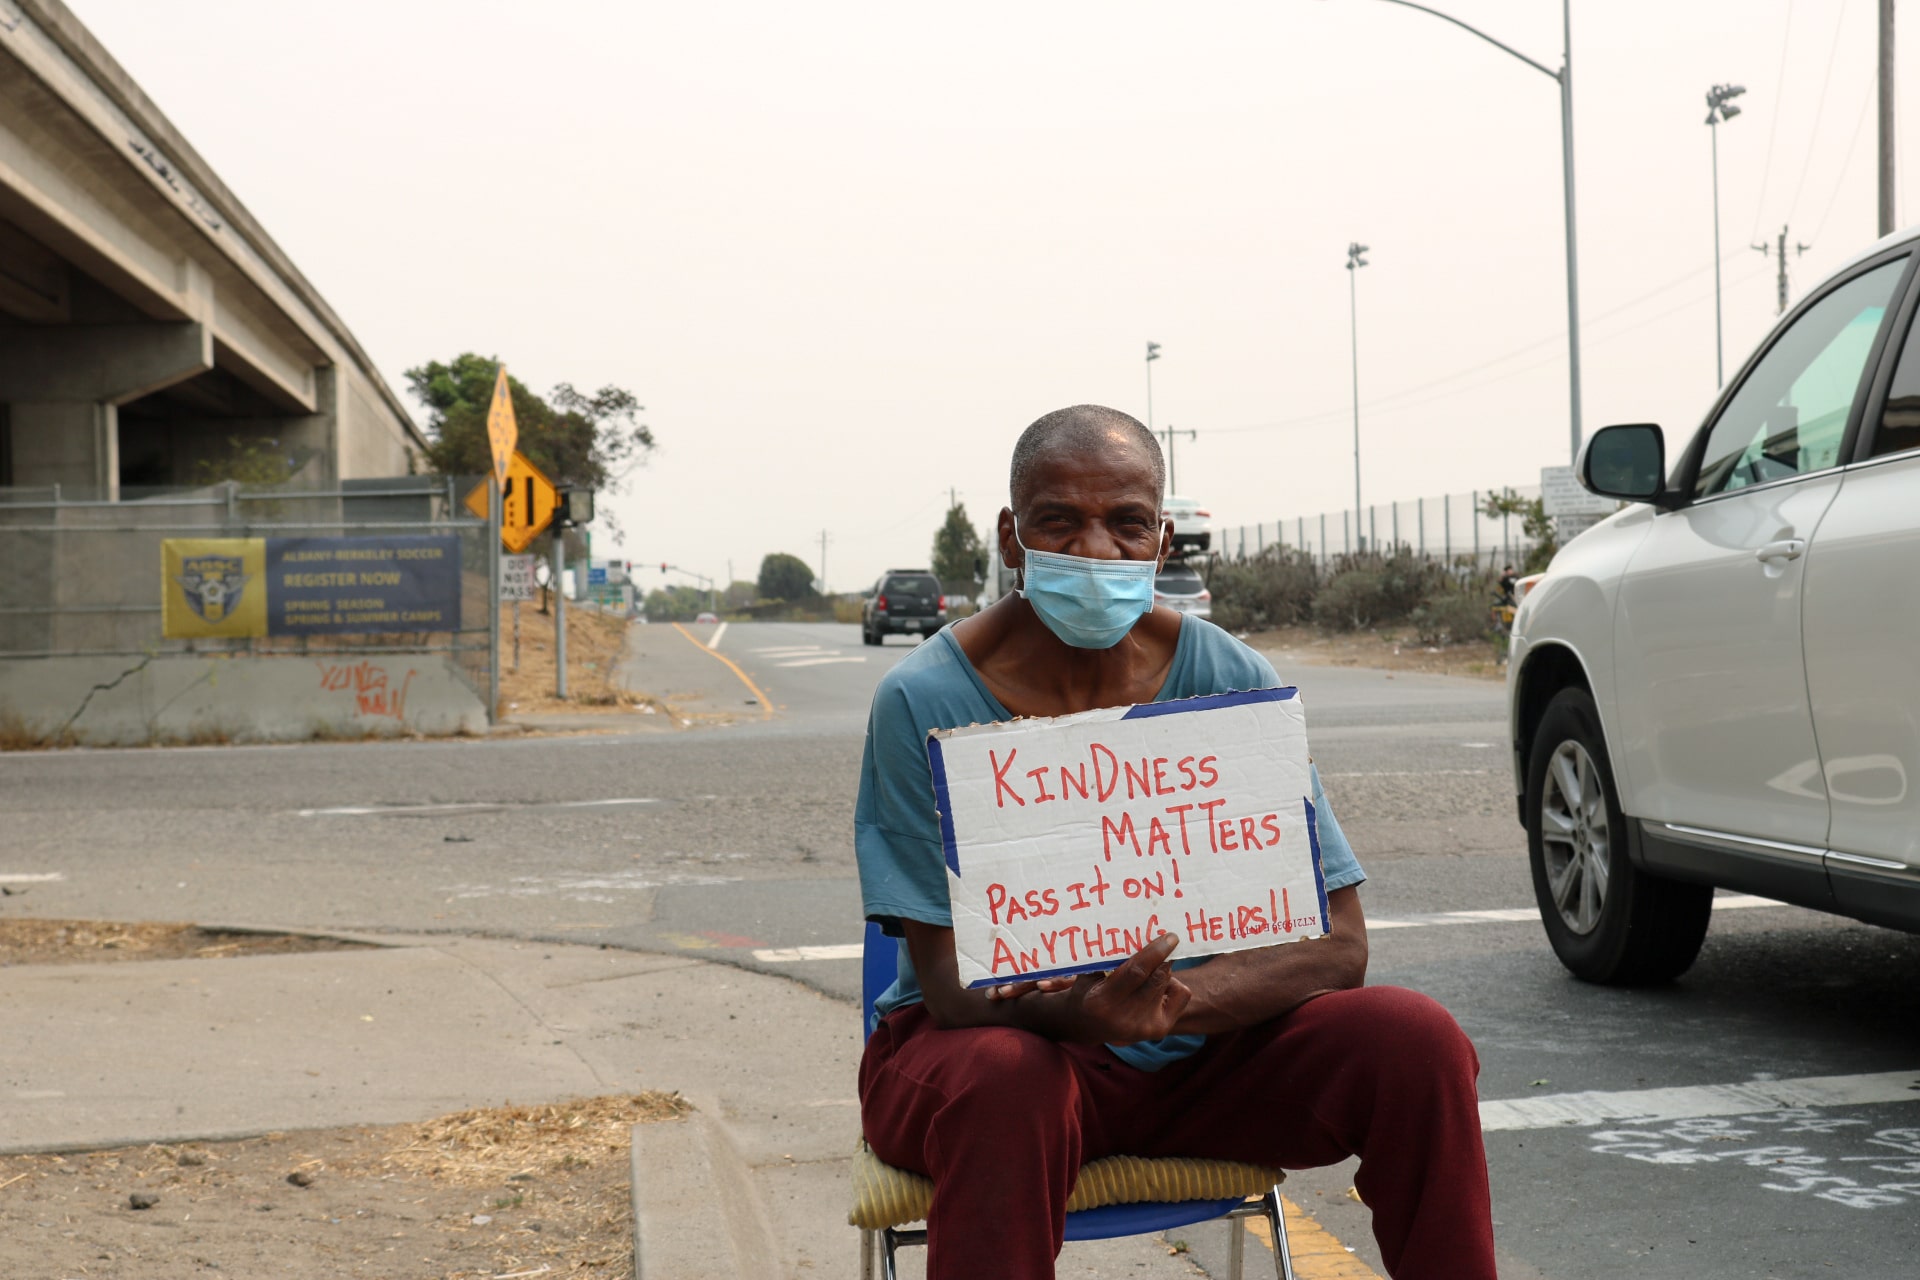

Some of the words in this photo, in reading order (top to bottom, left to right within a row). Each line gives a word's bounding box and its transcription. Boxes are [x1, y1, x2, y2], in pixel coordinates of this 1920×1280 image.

[397, 548, 443, 560] SOCCER
[507, 559, 525, 570] DO
[283, 572, 357, 587] REGISTER
[360, 571, 401, 586] NOW
[504, 572, 528, 583] NOT
[501, 586, 533, 597] PASS
[285, 600, 331, 611] SPRING
[336, 598, 385, 610] SEASON
[285, 613, 331, 625] SPRING
[346, 611, 399, 623] SUMMER
[401, 610, 442, 622] CAMPS
[988, 743, 1219, 807] KINDNESS
[1102, 798, 1281, 862] MATTERS
[1123, 858, 1184, 900] ON!
